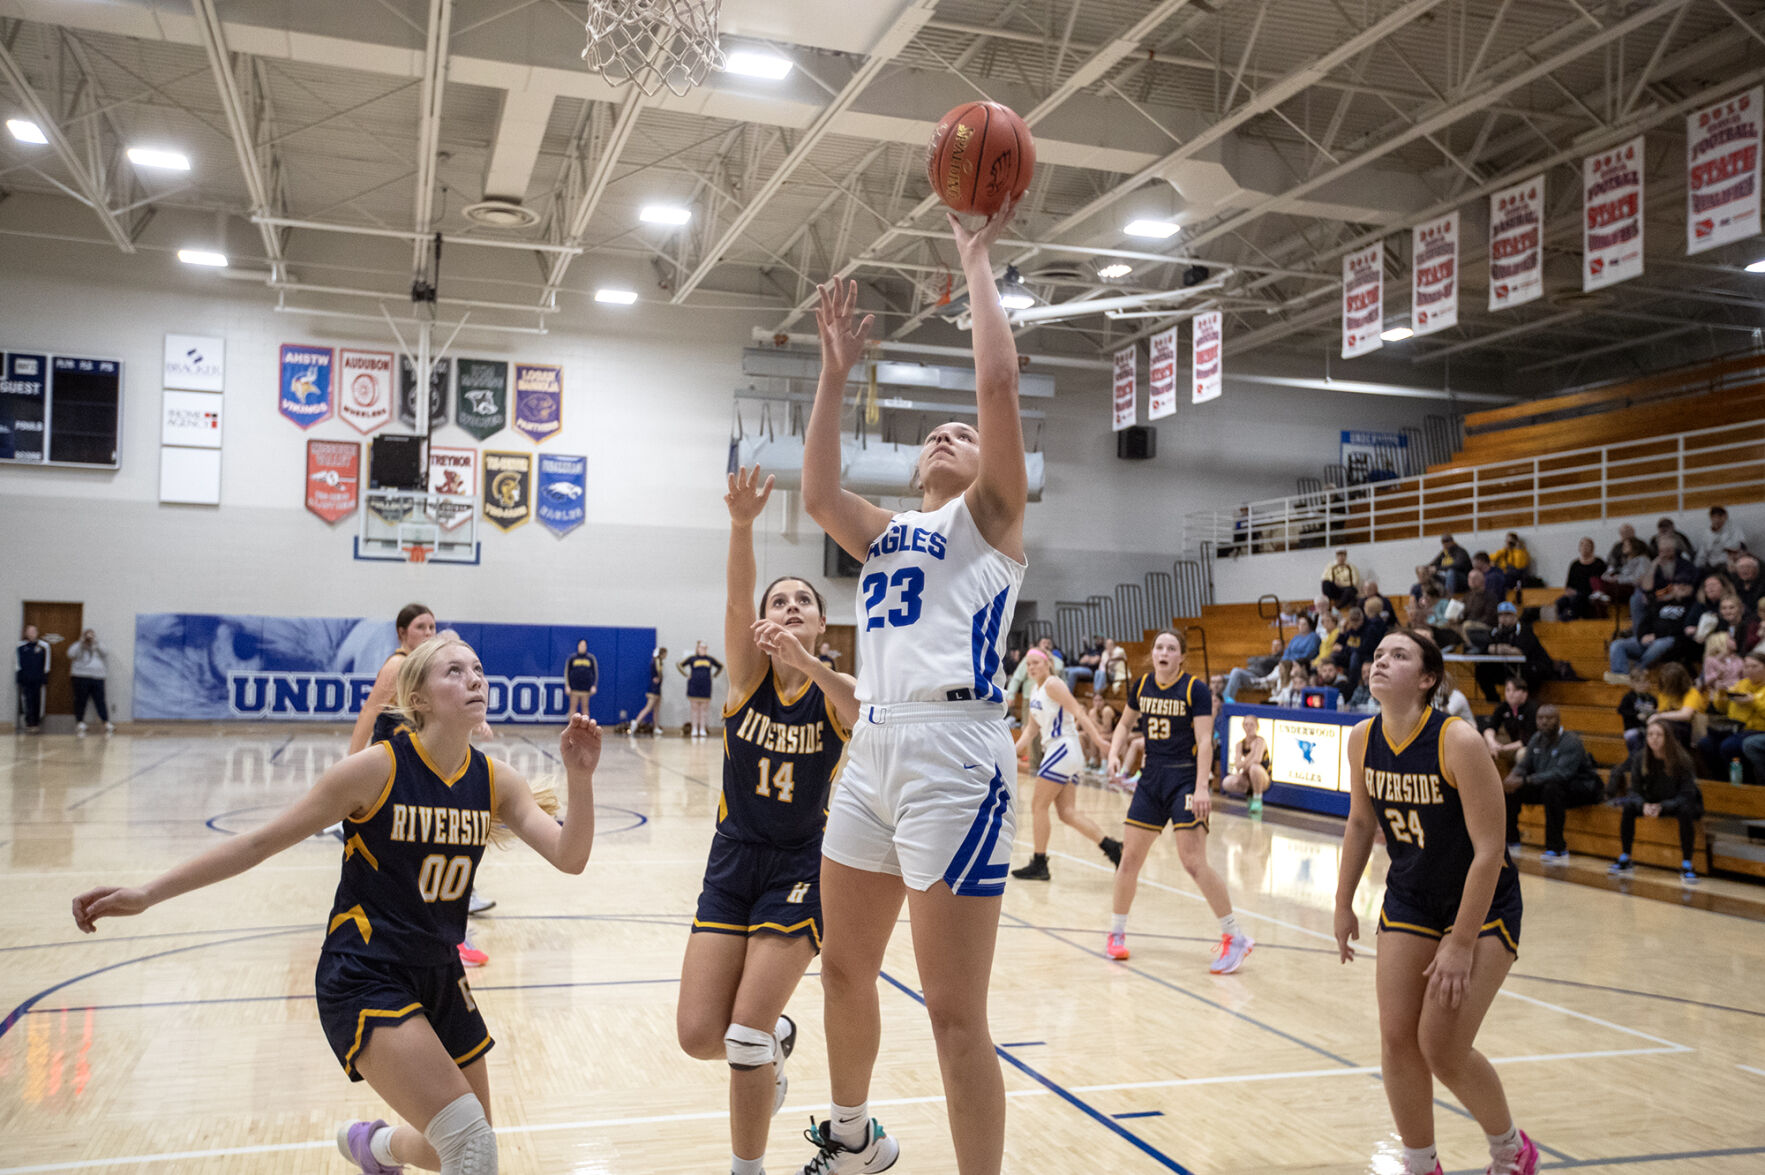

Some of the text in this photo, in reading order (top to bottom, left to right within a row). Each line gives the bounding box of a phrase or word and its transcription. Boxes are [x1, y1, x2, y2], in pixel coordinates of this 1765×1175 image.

[1691, 122, 1758, 162] FOOTBALL
[1691, 143, 1758, 191] STATE
[1588, 191, 1639, 230] STATE
[344, 357, 390, 371] AUDUBON
[0, 381, 41, 396] GUEST
[865, 524, 947, 560] AGLES
[862, 566, 925, 632] 23
[228, 670, 567, 722] UNDEOOD
[736, 706, 824, 754] RIVERSIDE
[1147, 716, 1172, 741] 23
[755, 757, 795, 803] 14
[390, 804, 491, 847] RIVERSID
[1384, 807, 1425, 850] 24
[418, 854, 472, 903] 00
